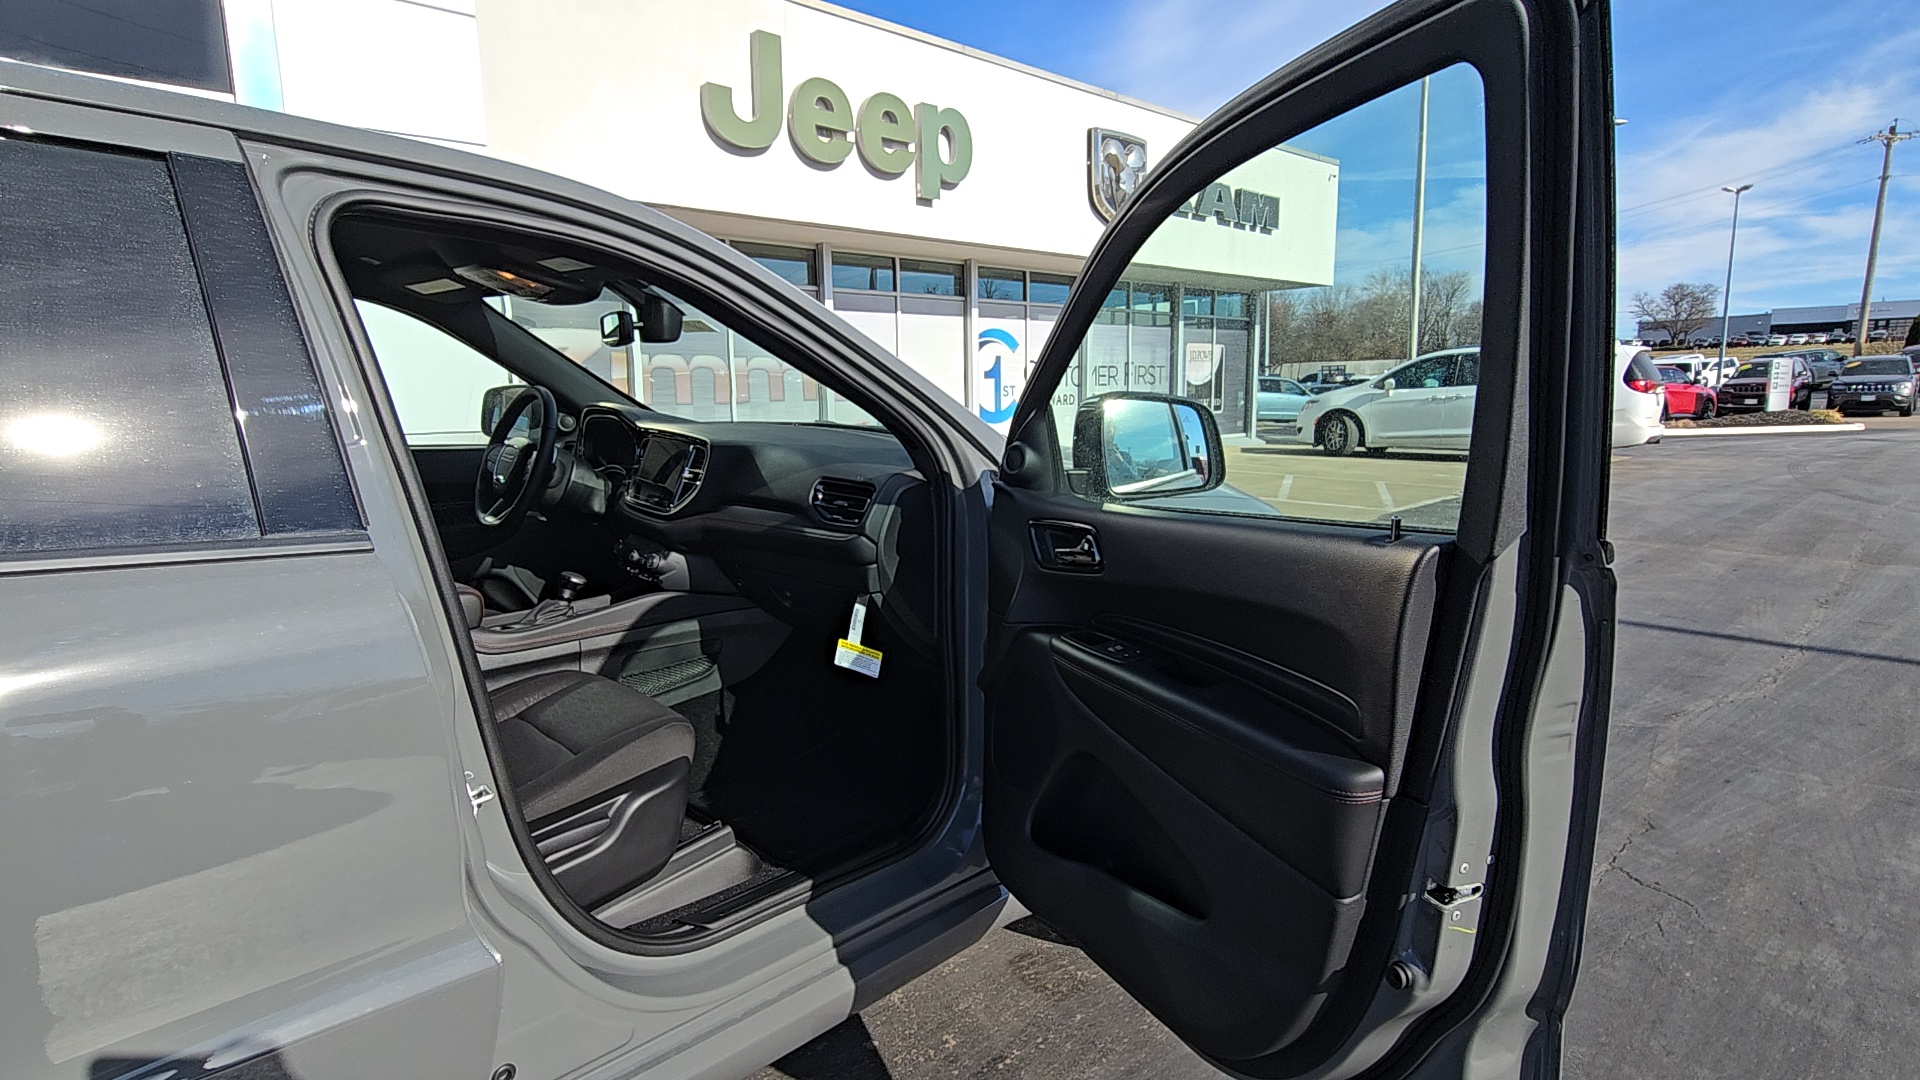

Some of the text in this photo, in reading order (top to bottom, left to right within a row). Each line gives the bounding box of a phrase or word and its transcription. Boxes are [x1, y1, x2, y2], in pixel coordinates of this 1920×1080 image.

[700, 29, 972, 204] Jeep
[1178, 182, 1281, 233] AM
[1123, 361, 1166, 387] FIRST
